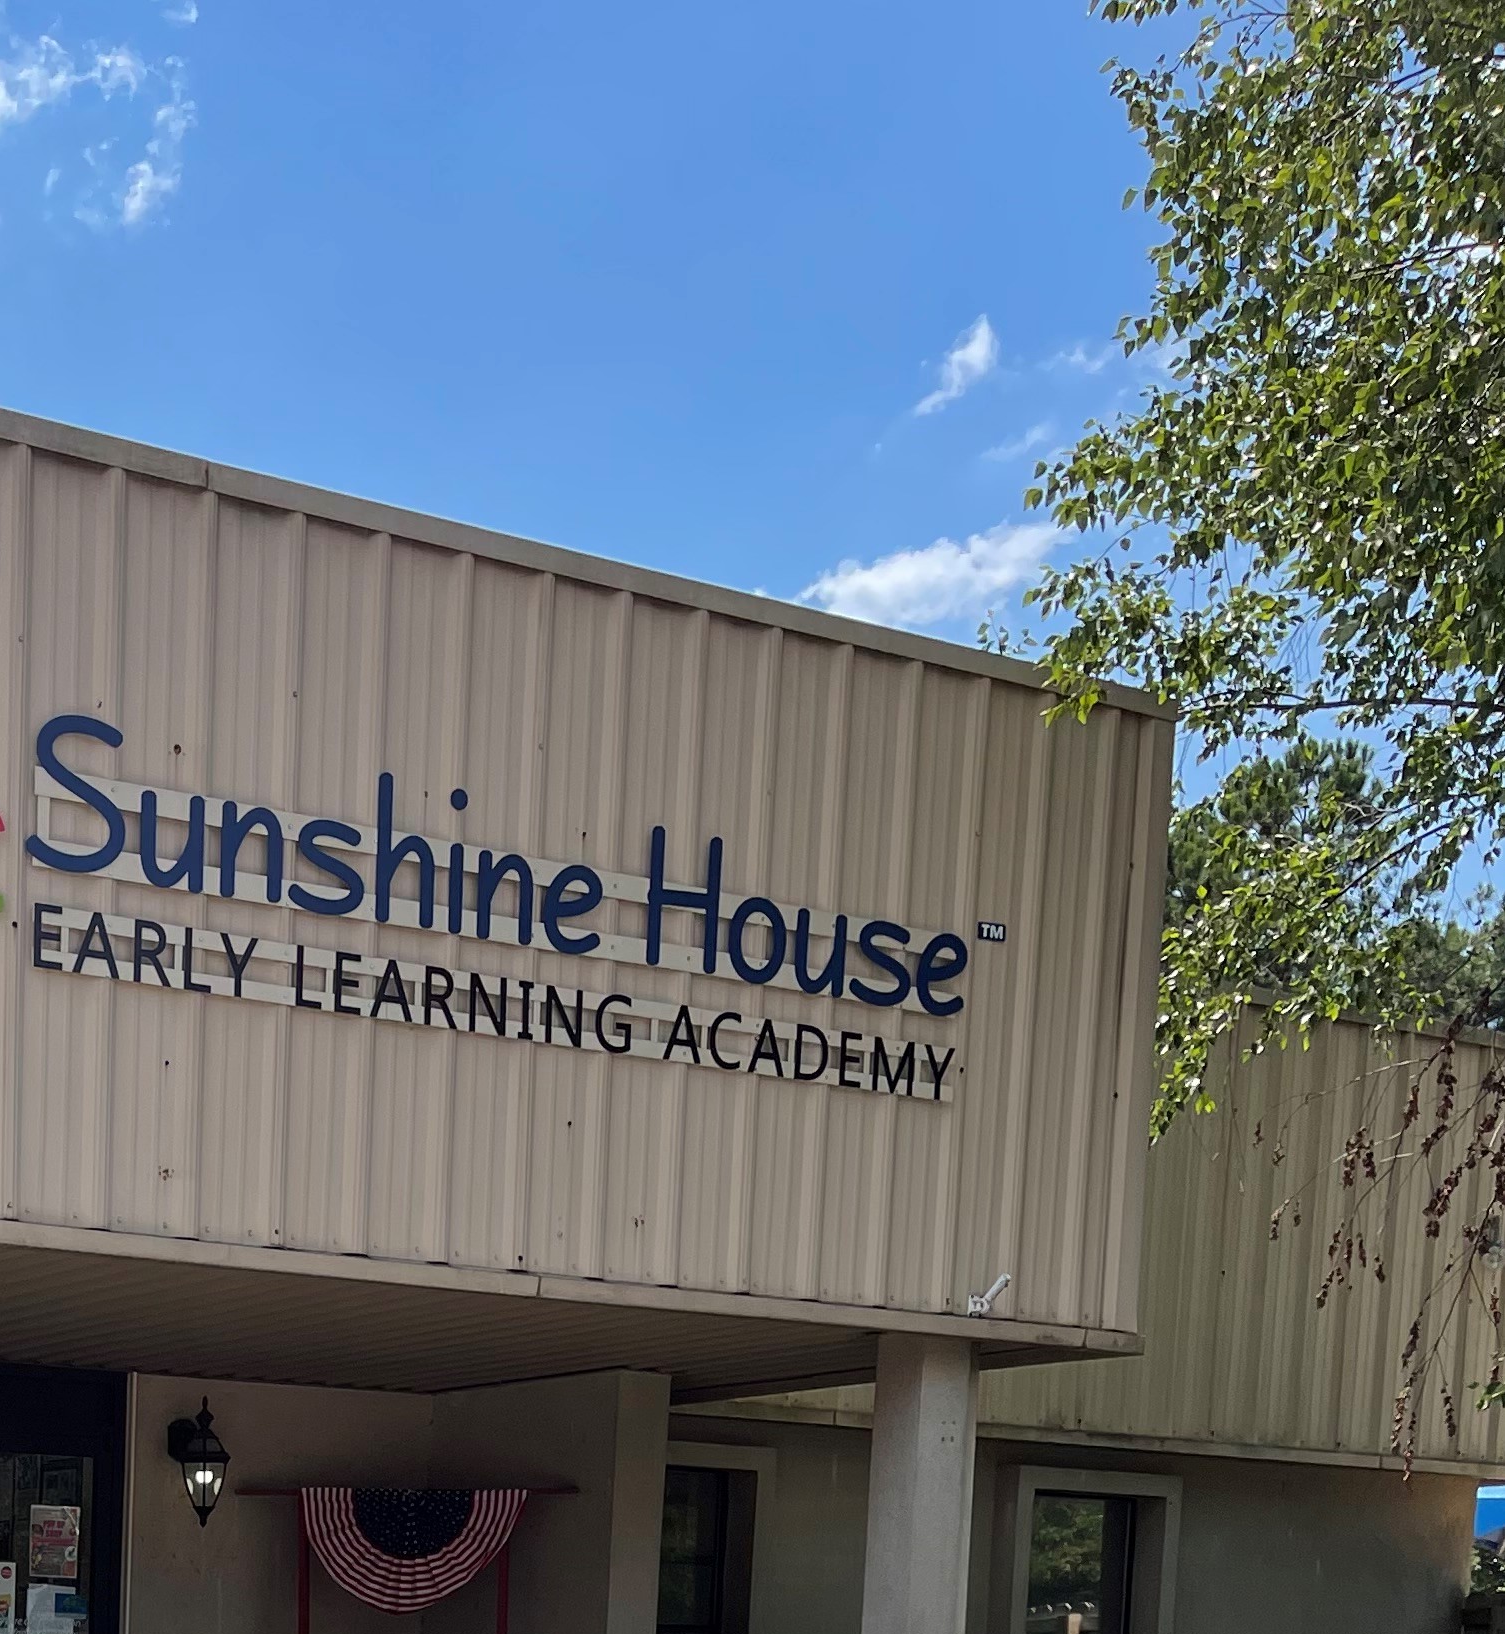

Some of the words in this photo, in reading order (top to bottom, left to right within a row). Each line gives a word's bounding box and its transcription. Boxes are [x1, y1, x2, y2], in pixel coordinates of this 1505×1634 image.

[25, 714, 603, 956] Sunshine
[645, 825, 968, 1017] House
[33, 902, 259, 998] EARLY
[295, 944, 632, 1054] LEARNING
[662, 1004, 956, 1101] ACADEMY
